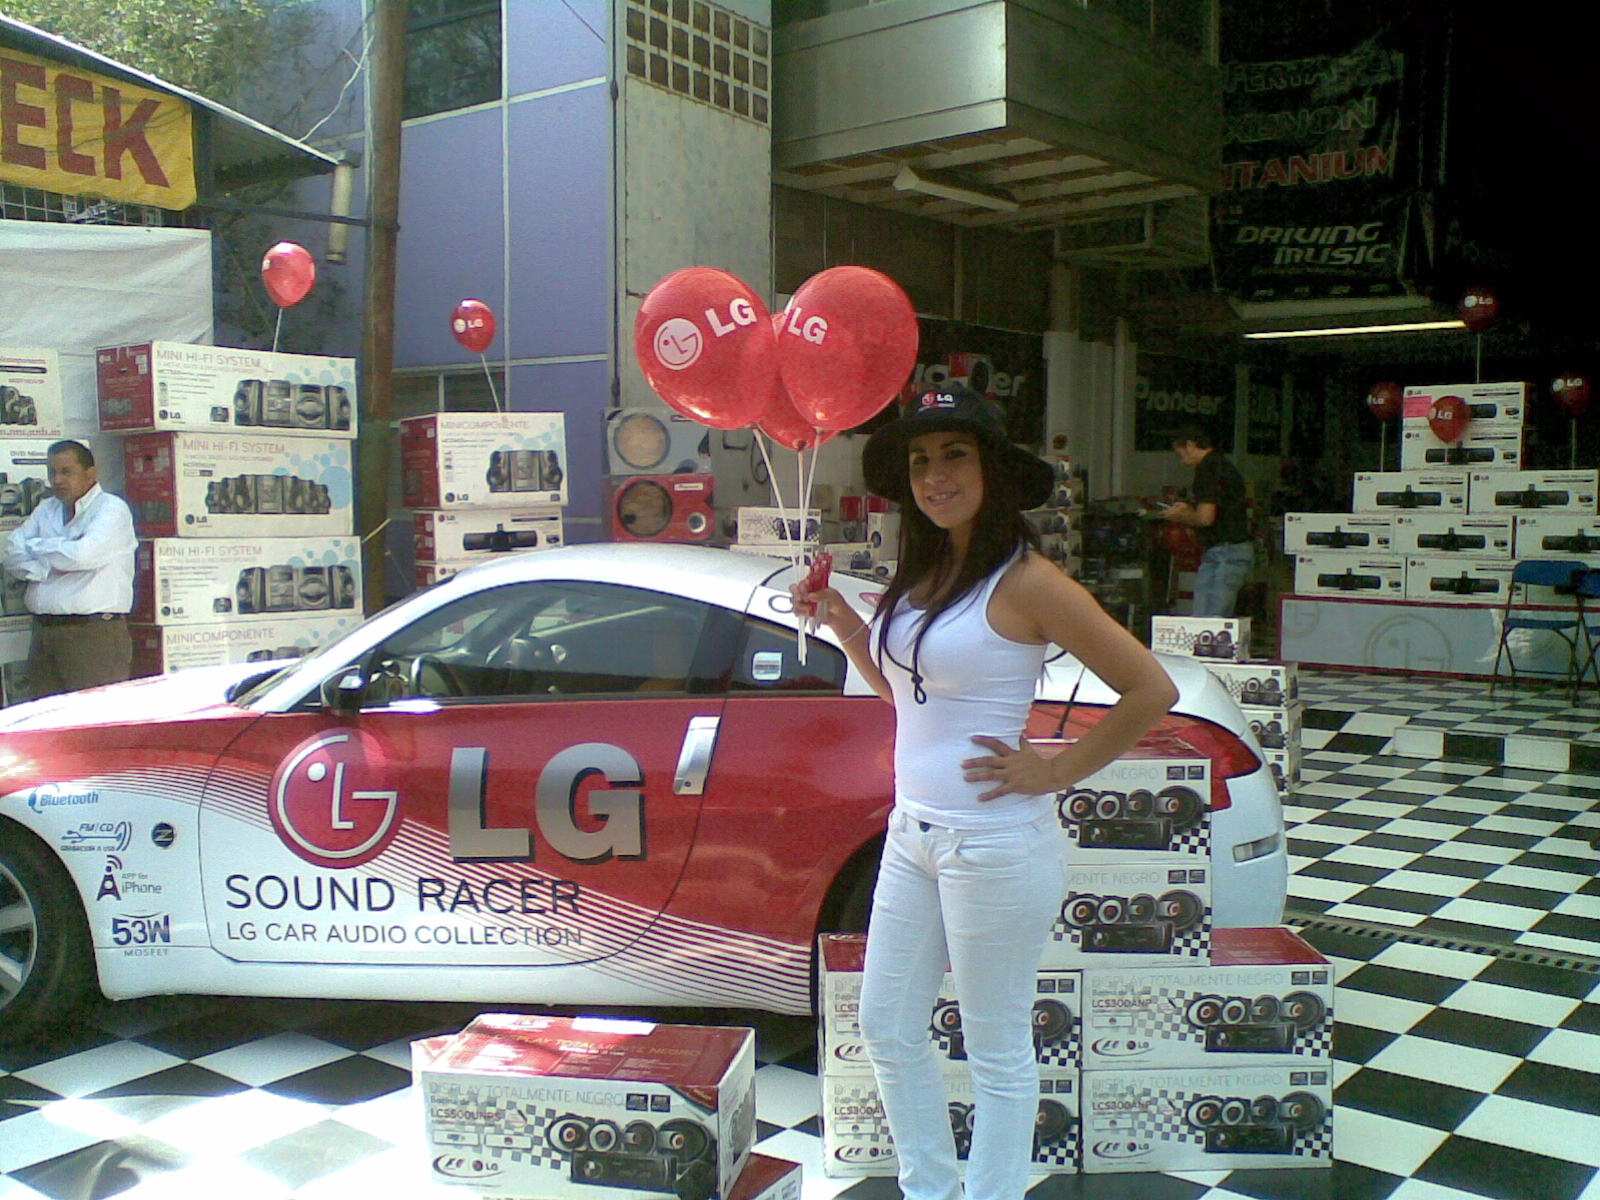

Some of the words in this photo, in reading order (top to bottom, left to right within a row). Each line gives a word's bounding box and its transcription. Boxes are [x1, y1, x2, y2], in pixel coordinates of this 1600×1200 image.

[0, 58, 171, 189] ECK
[1222, 146, 1395, 190] ITANIUM
[467, 319, 484, 328] LG
[705, 297, 757, 337] LG
[788, 307, 828, 345] LG
[1567, 378, 1583, 387] LG
[936, 394, 953, 402] LG
[167, 628, 275, 644] MINICOMPONENTE
[40, 791, 99, 807] Bluetooth
[448, 741, 646, 864] LG
[121, 881, 163, 895] iPhone
[225, 874, 395, 912] SOUND
[418, 878, 581, 915] RACER
[112, 914, 171, 946] 53W
[227, 921, 257, 942] LG
[265, 922, 317, 942] CAR
[326, 923, 407, 945] AUDIO
[415, 925, 582, 947] COLLECTION
[485, 1085, 572, 1103] TOTALMENTE
[576, 1091, 624, 1106] NEGRO
[881, 1148, 893, 1156] LG
[486, 1162, 498, 1171] LG
